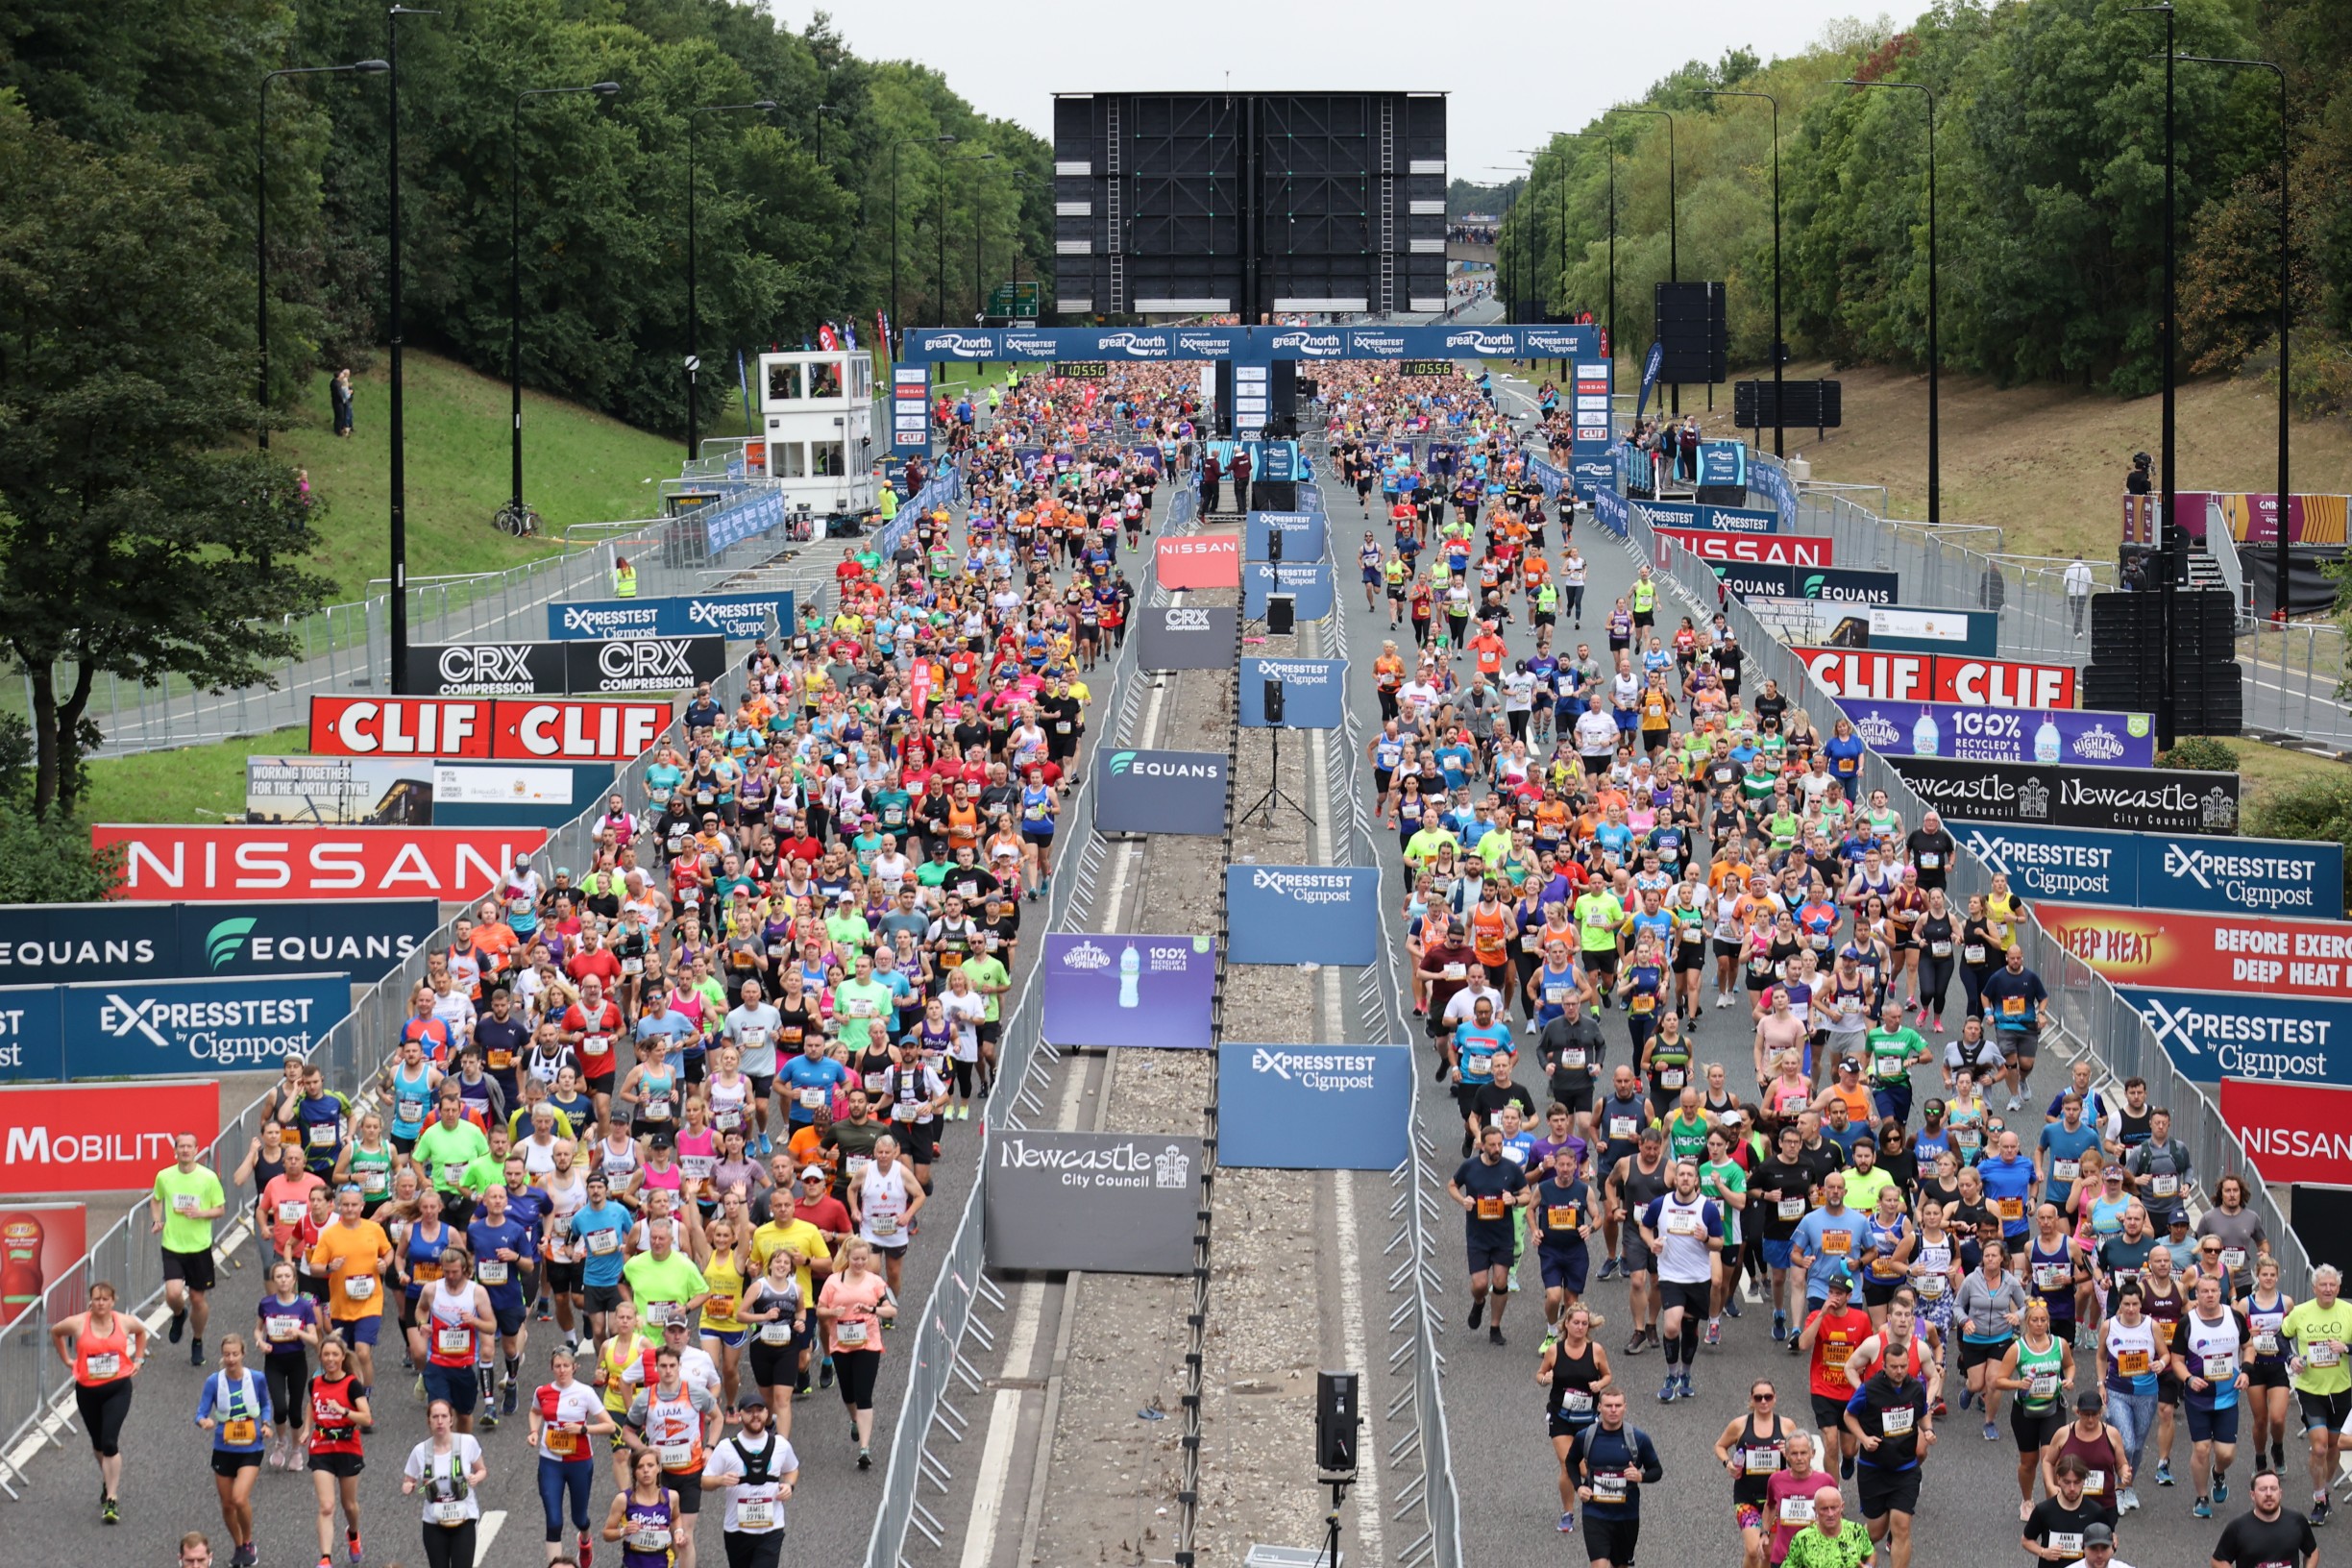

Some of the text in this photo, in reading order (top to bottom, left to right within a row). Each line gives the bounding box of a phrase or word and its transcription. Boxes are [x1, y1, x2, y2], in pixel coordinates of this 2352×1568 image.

[925, 336, 991, 351] great north
[1007, 338, 1056, 352] EXPRESSTEST
[1099, 336, 1165, 350] great north
[1180, 338, 1230, 351] EXPRESSTEST
[1272, 334, 1339, 348] great north
[1354, 337, 1404, 350] EXPRESSTEST
[1447, 334, 1513, 347] great north
[1528, 336, 1578, 350] EXPRESSTEST
[1549, 344, 1577, 353] Cignpost
[975, 349, 994, 357] run
[1029, 347, 1055, 356] Cignpost
[1149, 348, 1168, 356] run
[1201, 346, 1229, 355] Cignpost
[1375, 344, 1403, 354] Cignpost
[1260, 514, 1310, 526] EXPRESSTEST
[1640, 505, 1693, 526] XPRESSTEST
[1713, 511, 1768, 531] EXPRESSTEST
[1161, 543, 1235, 554] NISSAN
[1260, 566, 1317, 579] EXRESSTEST
[1283, 576, 1316, 586] Cignpost
[1723, 578, 1784, 596] EQUANS
[1822, 586, 1888, 603] EQUANS
[689, 600, 778, 627] EXPRESSTEST
[1165, 609, 1209, 625] CRX
[1780, 604, 1813, 615] TOGETHER
[564, 607, 658, 634] EXPRESSTEST
[726, 620, 766, 636] Cignpo
[1763, 615, 1773, 625] THE
[1775, 616, 1797, 626] NORTH
[1799, 617, 1807, 626] OF
[1809, 617, 1825, 627] TYNE
[439, 645, 534, 683] CRX
[599, 640, 694, 677] CRX
[1259, 660, 1329, 677] EXPRESSTEST
[1809, 653, 1919, 699] CLIF
[600, 676, 694, 691] COMPRESSION
[1287, 675, 1327, 684] Cignpost
[1955, 663, 2062, 709] CLIF
[440, 681, 534, 695] COMPRESSION
[339, 701, 477, 753] CLIF
[519, 705, 657, 756] CLIF
[1952, 711, 2021, 738] 100%
[1857, 724, 1899, 743] IGHLAND
[2073, 732, 2124, 758] HIGHLAND
[1956, 749, 2020, 761] RECYCLABLE
[2084, 750, 2112, 760] SPRING
[253, 765, 350, 781] WORKING TOGETHER
[1133, 762, 1217, 778] EQUANS
[253, 782, 369, 796] FOR THE NORTH OF TYNE
[1901, 774, 2015, 800] ewcastle
[2060, 778, 2198, 810] Newcastle
[1933, 802, 2014, 816] City Council
[2113, 812, 2197, 827] City Council
[1967, 830, 2112, 875] EXPRESSTEST
[129, 841, 511, 889] NISSAN
[2164, 844, 2315, 889] EXPRESSTEST
[1253, 869, 1352, 894] EXPRESSTEST
[2025, 867, 2109, 896] Cignpost
[1294, 888, 1351, 904] Cignpost
[2225, 880, 2313, 909] Cignpost
[252, 935, 414, 960] EQUANS
[2057, 925, 2159, 965] DEEP HEAT
[2215, 928, 2288, 955] BEFORE
[1063, 952, 1110, 966] HIGHLAND
[1150, 947, 1187, 959] 100%
[2233, 959, 2340, 987] DEEP HEAT
[101, 994, 313, 1047] EXPRESSTEST
[2143, 999, 2331, 1054] EXPRESSTEST
[176, 1030, 311, 1065] by Cignpost
[1252, 1048, 1375, 1080] EXPRESSTEST
[2207, 1041, 2327, 1079] by Cignpost
[1302, 1072, 1374, 1091] Cignpost
[2242, 1126, 2352, 1161] NISSAN
[1001, 1139, 1151, 1172] Newcastle
[1062, 1173, 1149, 1189] City Council
[657, 1408, 681, 1417] LIAM
